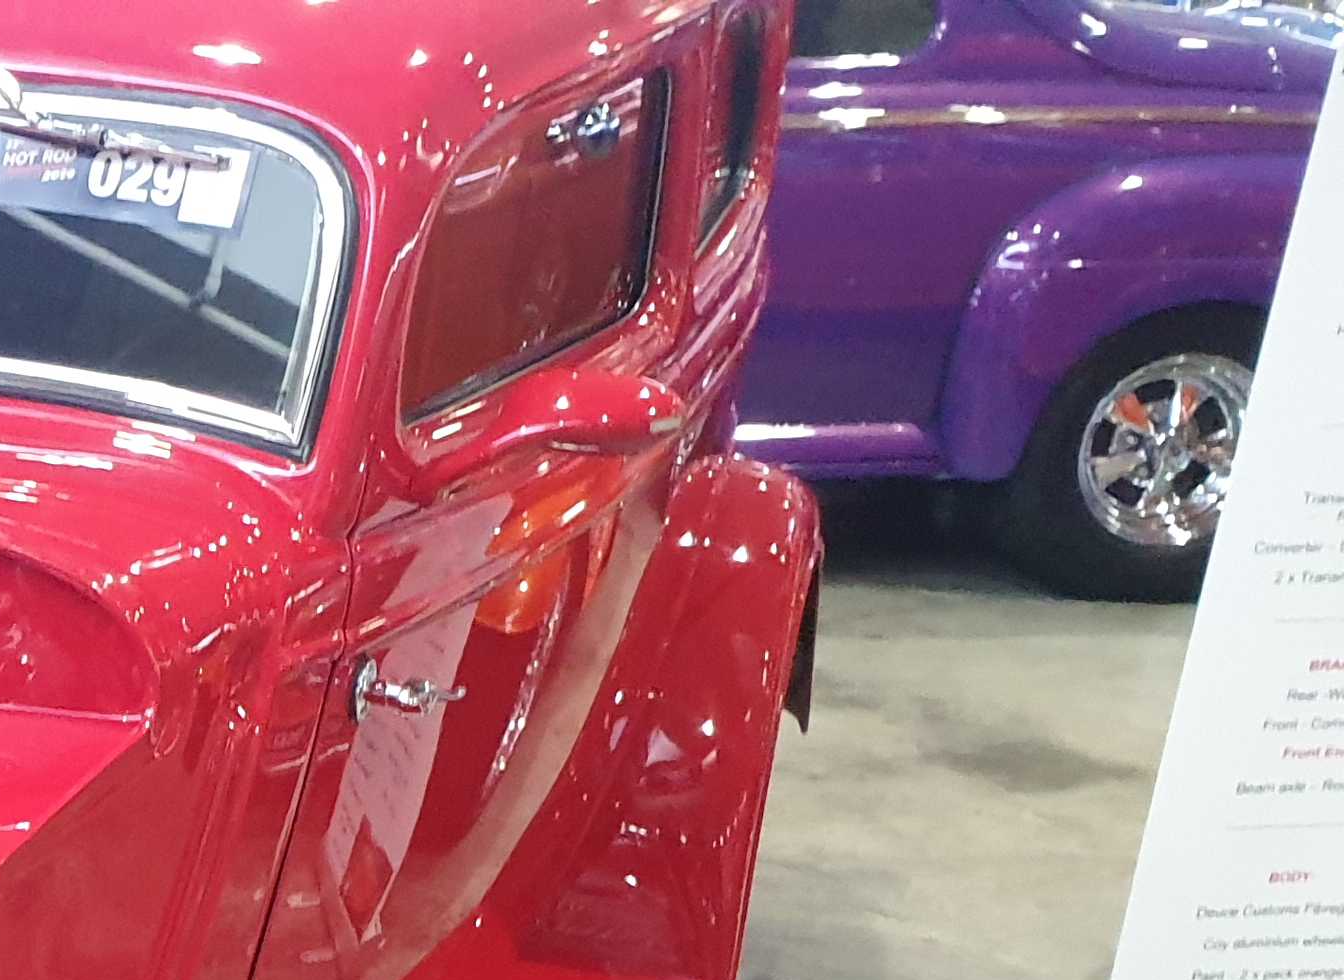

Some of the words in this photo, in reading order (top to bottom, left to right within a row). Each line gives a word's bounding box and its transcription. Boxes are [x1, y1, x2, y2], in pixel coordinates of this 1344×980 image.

[2, 150, 38, 167] HOT
[42, 148, 78, 164] ROD
[87, 150, 186, 207] 029
[1263, 718, 1298, 731] Front
[1282, 747, 1321, 760] Front
